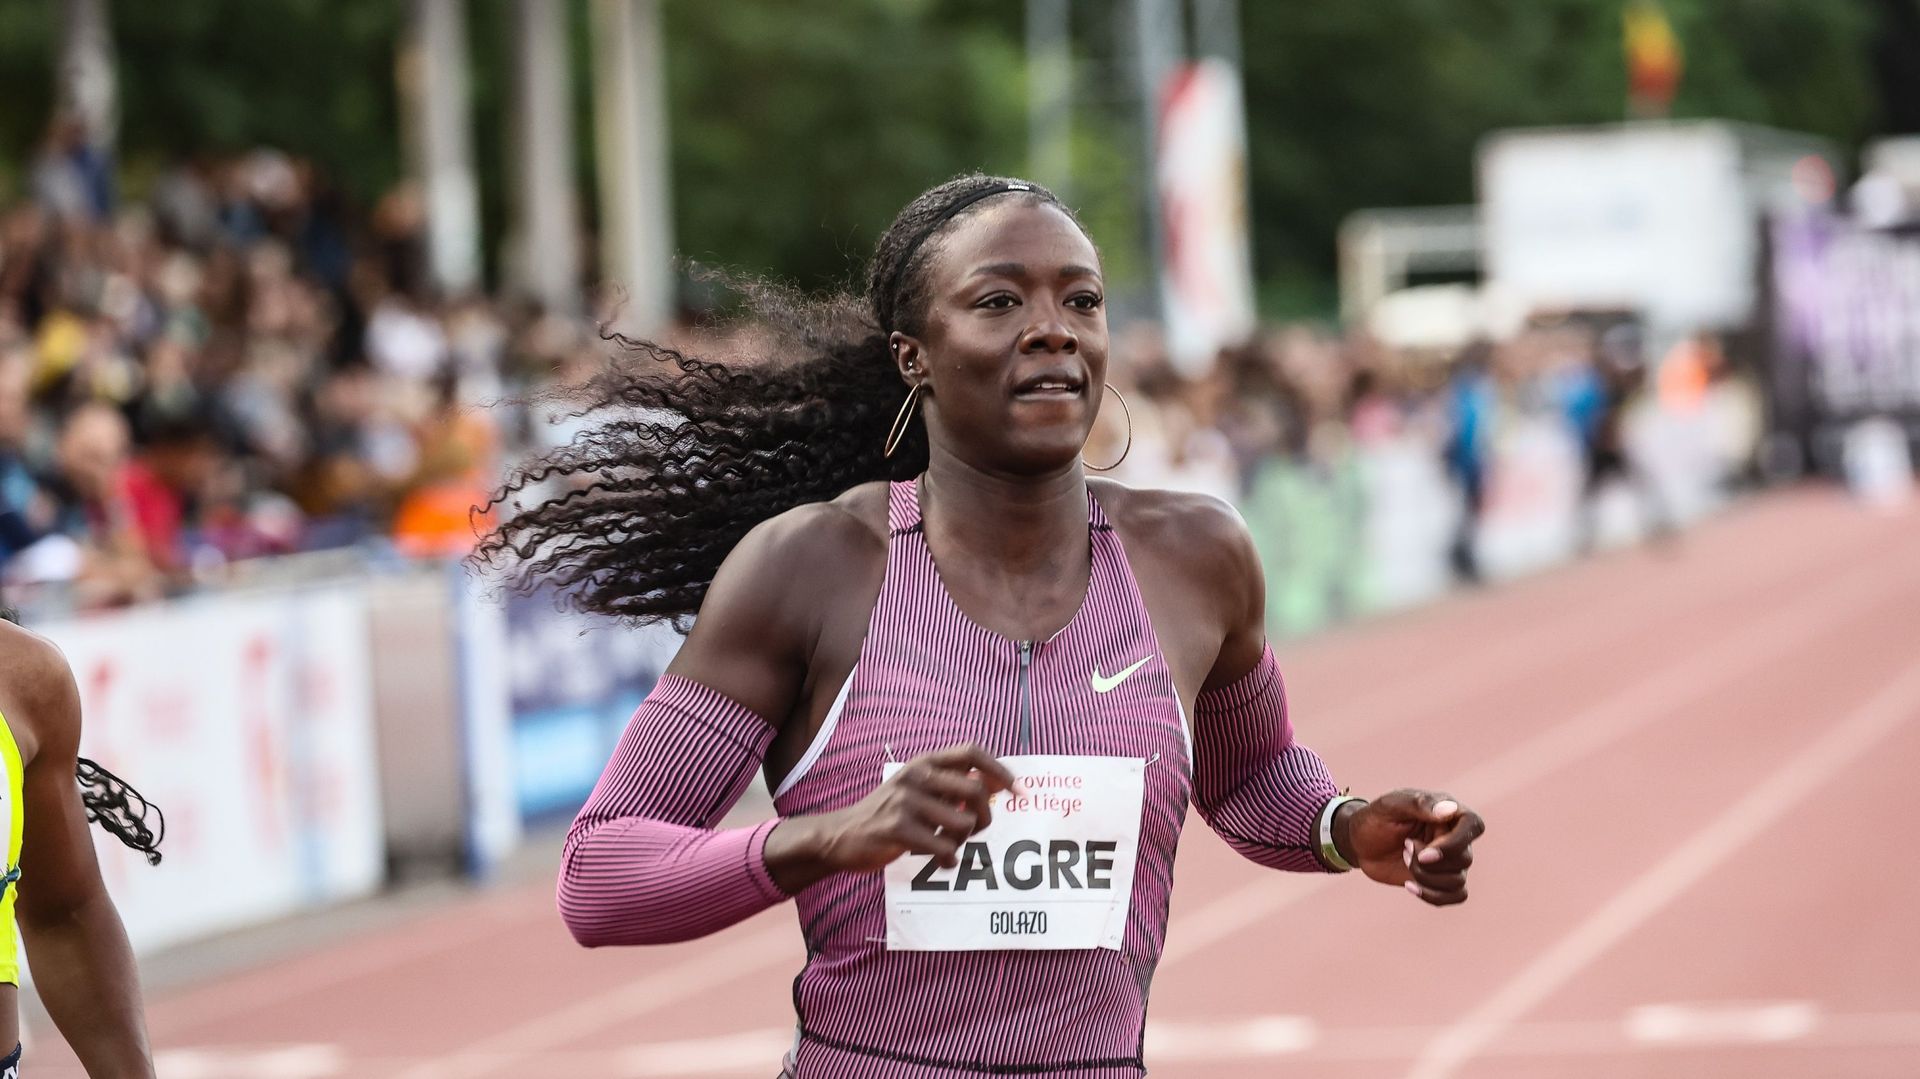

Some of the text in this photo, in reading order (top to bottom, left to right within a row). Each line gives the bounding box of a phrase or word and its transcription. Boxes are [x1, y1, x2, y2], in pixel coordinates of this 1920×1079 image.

[1014, 771, 1082, 788] rovince
[1006, 792, 1029, 812] de
[910, 840, 1117, 891] ZAGRE
[990, 911, 1047, 935] GOLAZO
